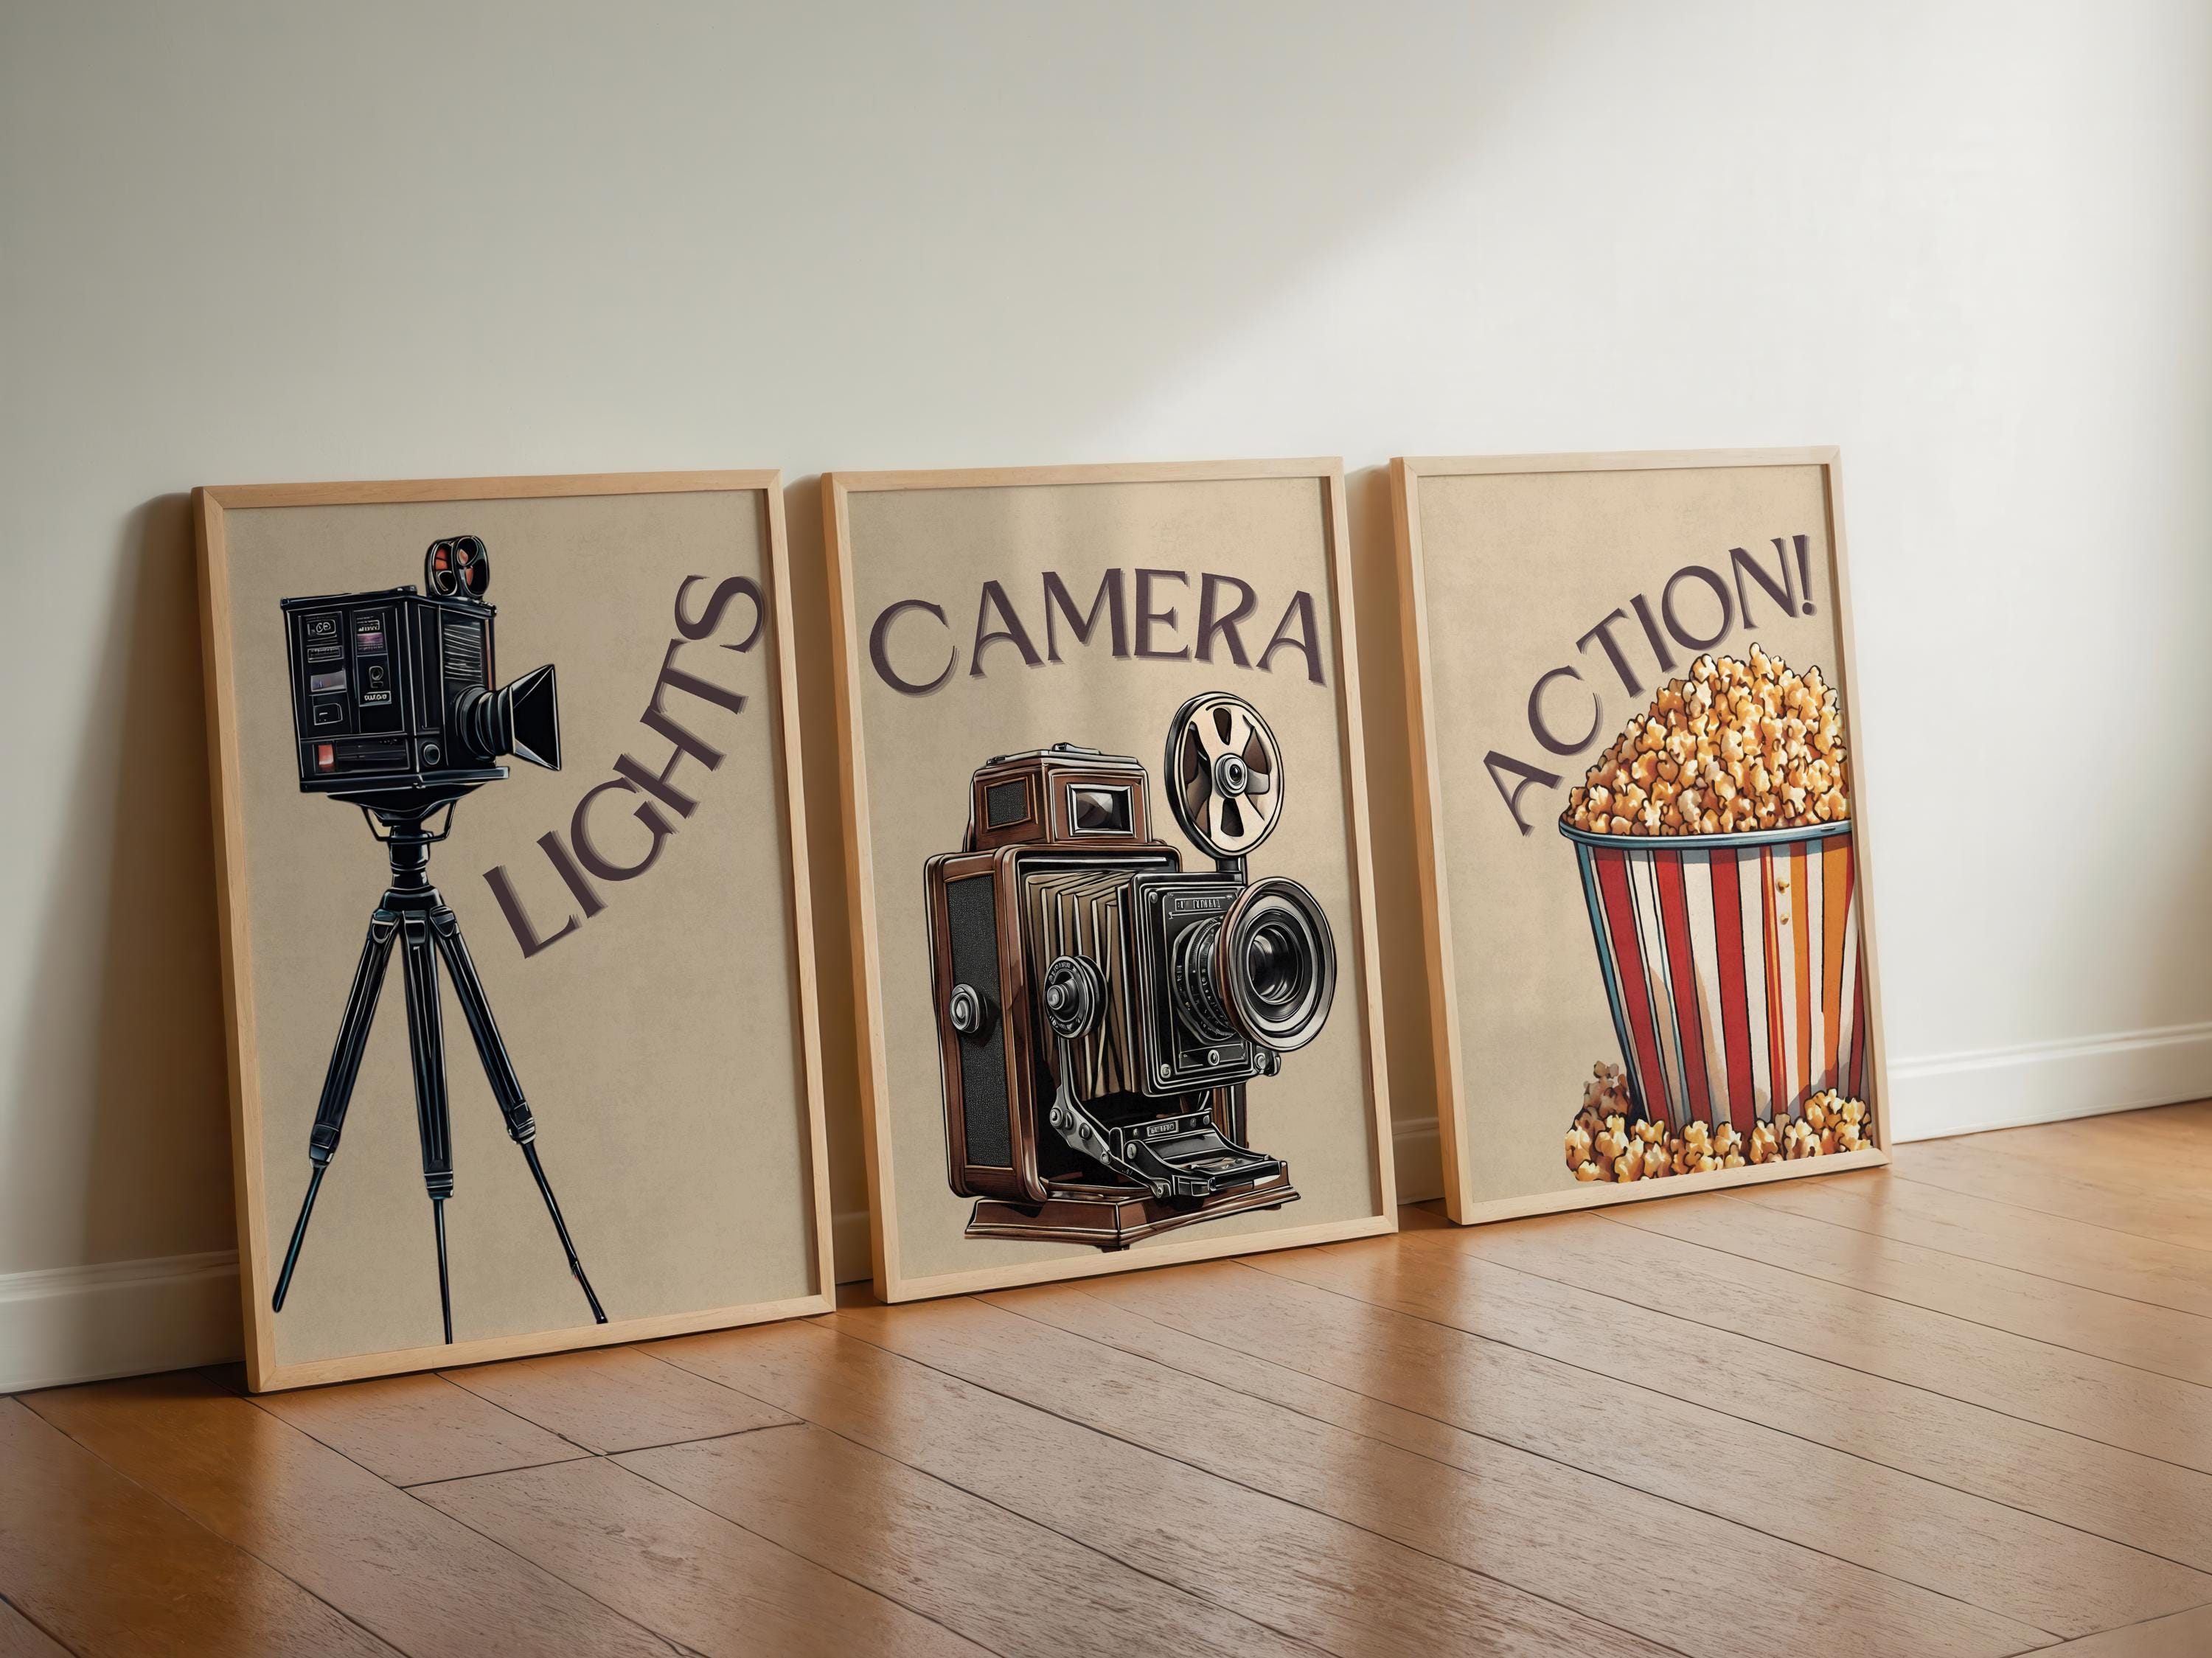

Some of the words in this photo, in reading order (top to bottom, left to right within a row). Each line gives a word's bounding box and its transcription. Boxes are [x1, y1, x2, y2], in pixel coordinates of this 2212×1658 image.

[483, 575, 765, 958] LIGHTS
[869, 568, 1326, 697] CAMERA
[1483, 534, 1816, 837] ACTION!
